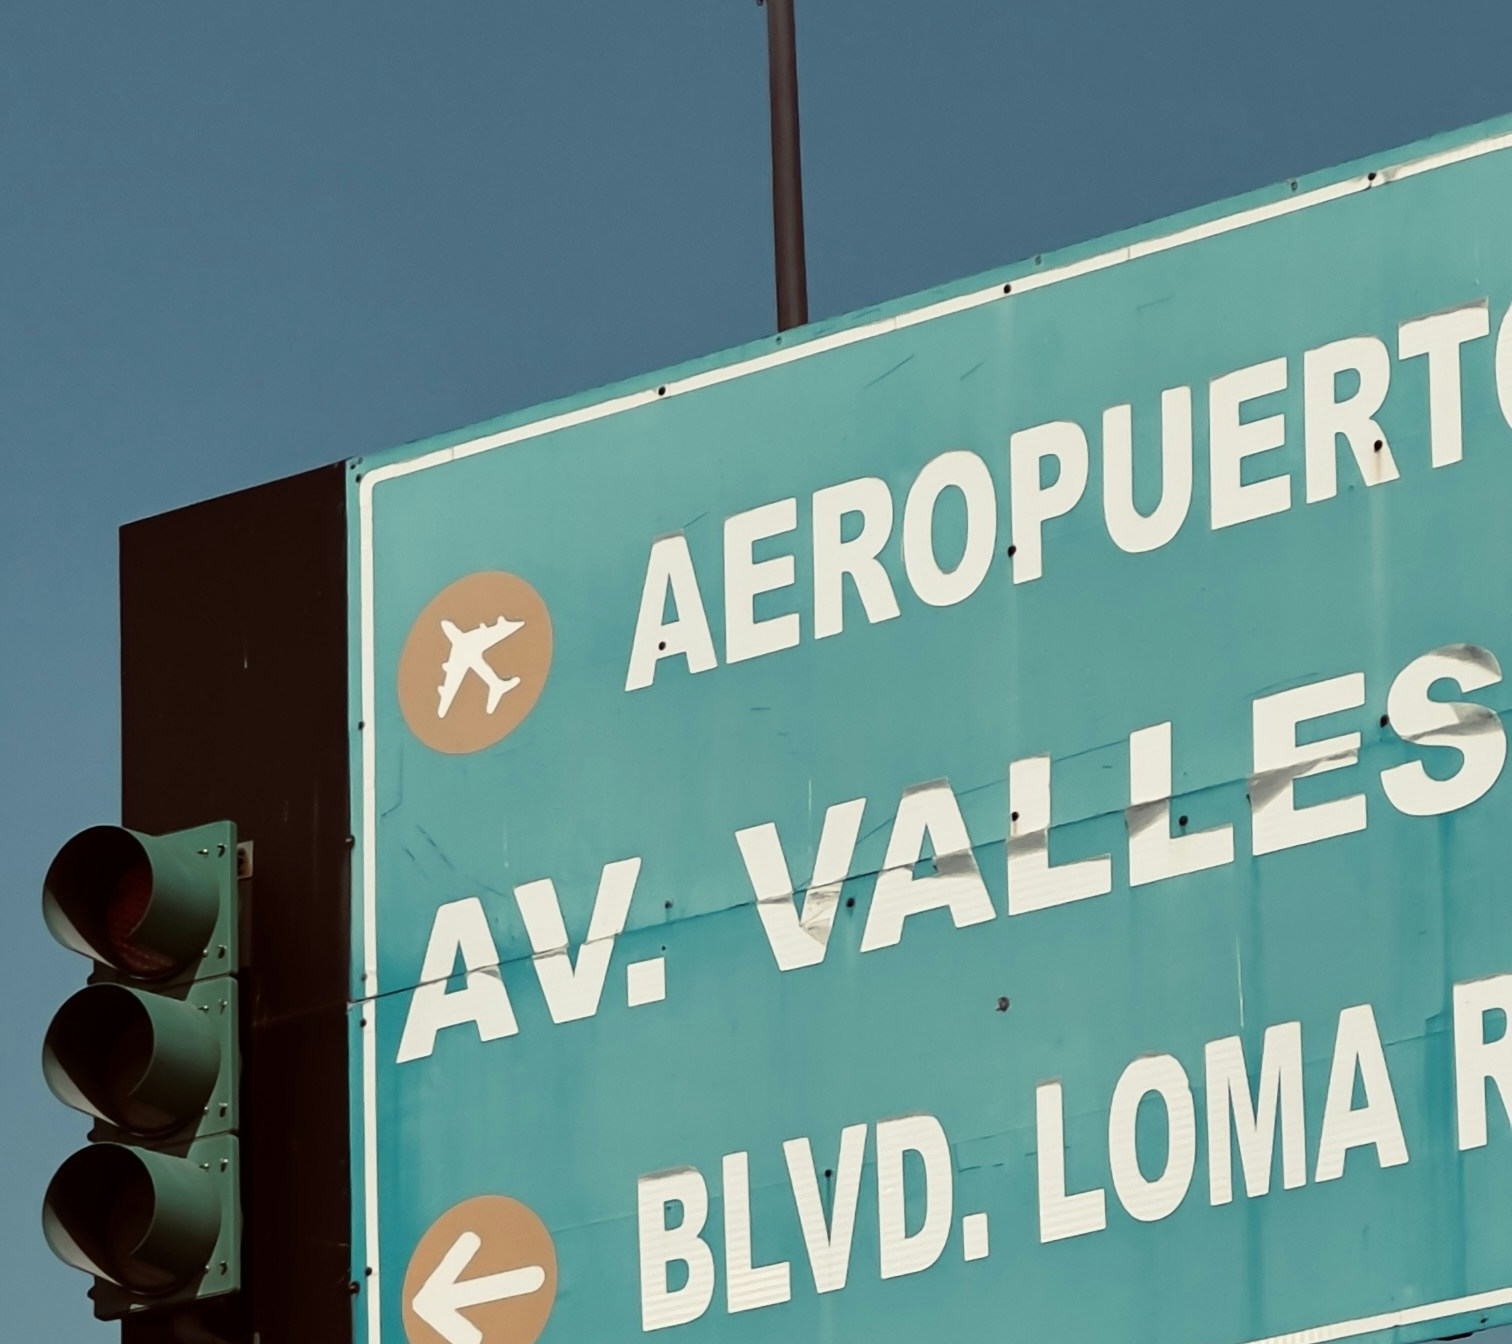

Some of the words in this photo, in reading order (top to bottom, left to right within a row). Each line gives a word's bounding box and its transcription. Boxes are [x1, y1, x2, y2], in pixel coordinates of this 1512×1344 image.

[625, 297, 1512, 693] AEROPUERT
[397, 855, 666, 1064] AV.
[734, 645, 1507, 971] VALLES
[637, 1112, 990, 1332] BLVD.
[1035, 1004, 1409, 1244] LOMA
